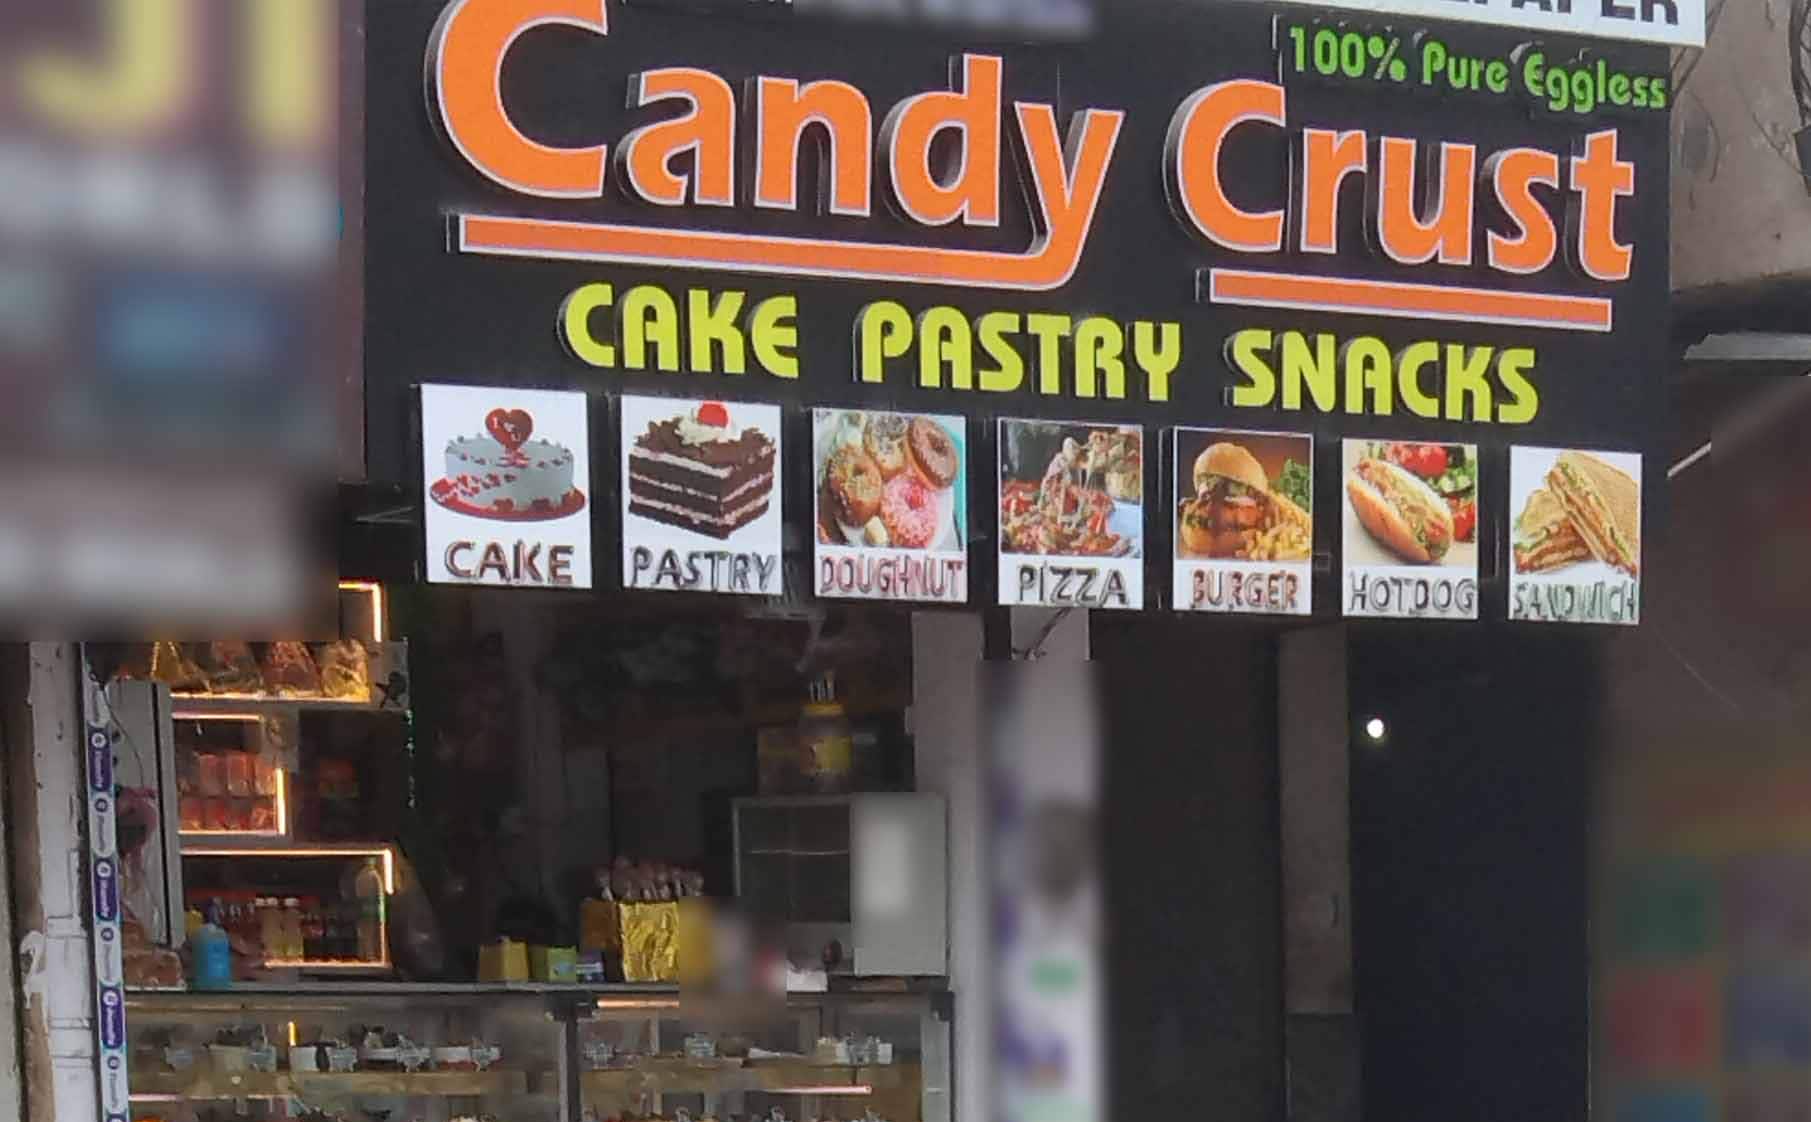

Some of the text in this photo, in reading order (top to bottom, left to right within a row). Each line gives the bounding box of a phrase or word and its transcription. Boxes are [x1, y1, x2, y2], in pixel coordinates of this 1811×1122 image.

[1290, 25, 1667, 113] 100% Pure Eggless
[432, 0, 1126, 291] Candy
[1174, 78, 1635, 282] Crust
[562, 282, 1540, 425] CAKE PASTRY SNACKS
[445, 539, 575, 585] CAKE
[630, 545, 776, 592] PASTRY
[820, 554, 963, 598] DOUGHNUT
[1017, 562, 1129, 606] PIZZA
[1190, 568, 1299, 610] BURGER
[1349, 571, 1476, 615] HOTDOG
